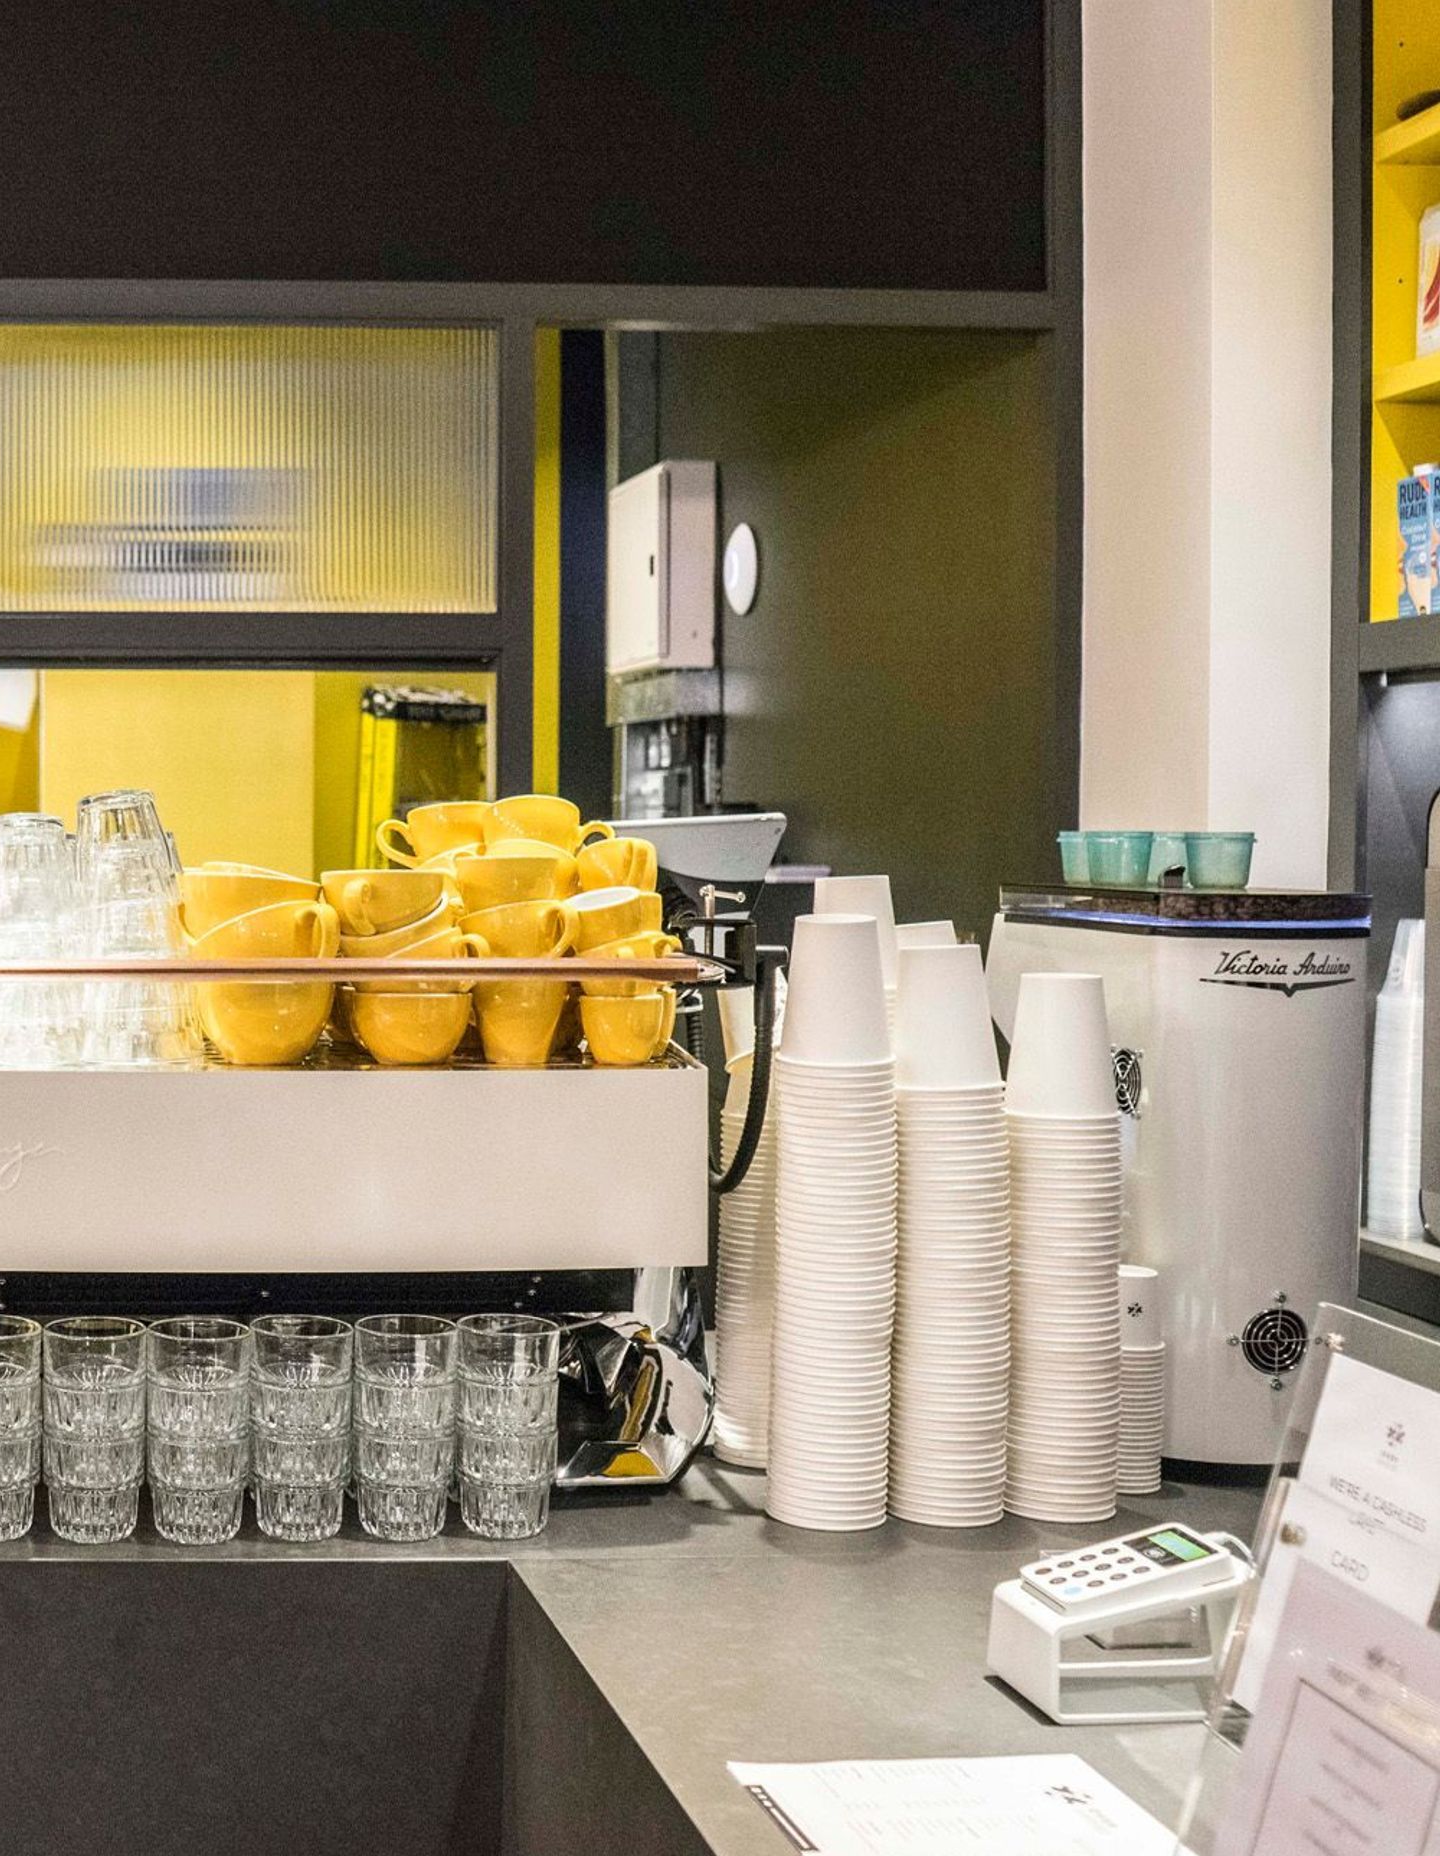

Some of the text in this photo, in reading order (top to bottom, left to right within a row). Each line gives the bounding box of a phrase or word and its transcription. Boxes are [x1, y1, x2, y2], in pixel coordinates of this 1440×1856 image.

[1214, 950, 1351, 976] Victoria Arduino
[1330, 1549, 1370, 1582] CARD
